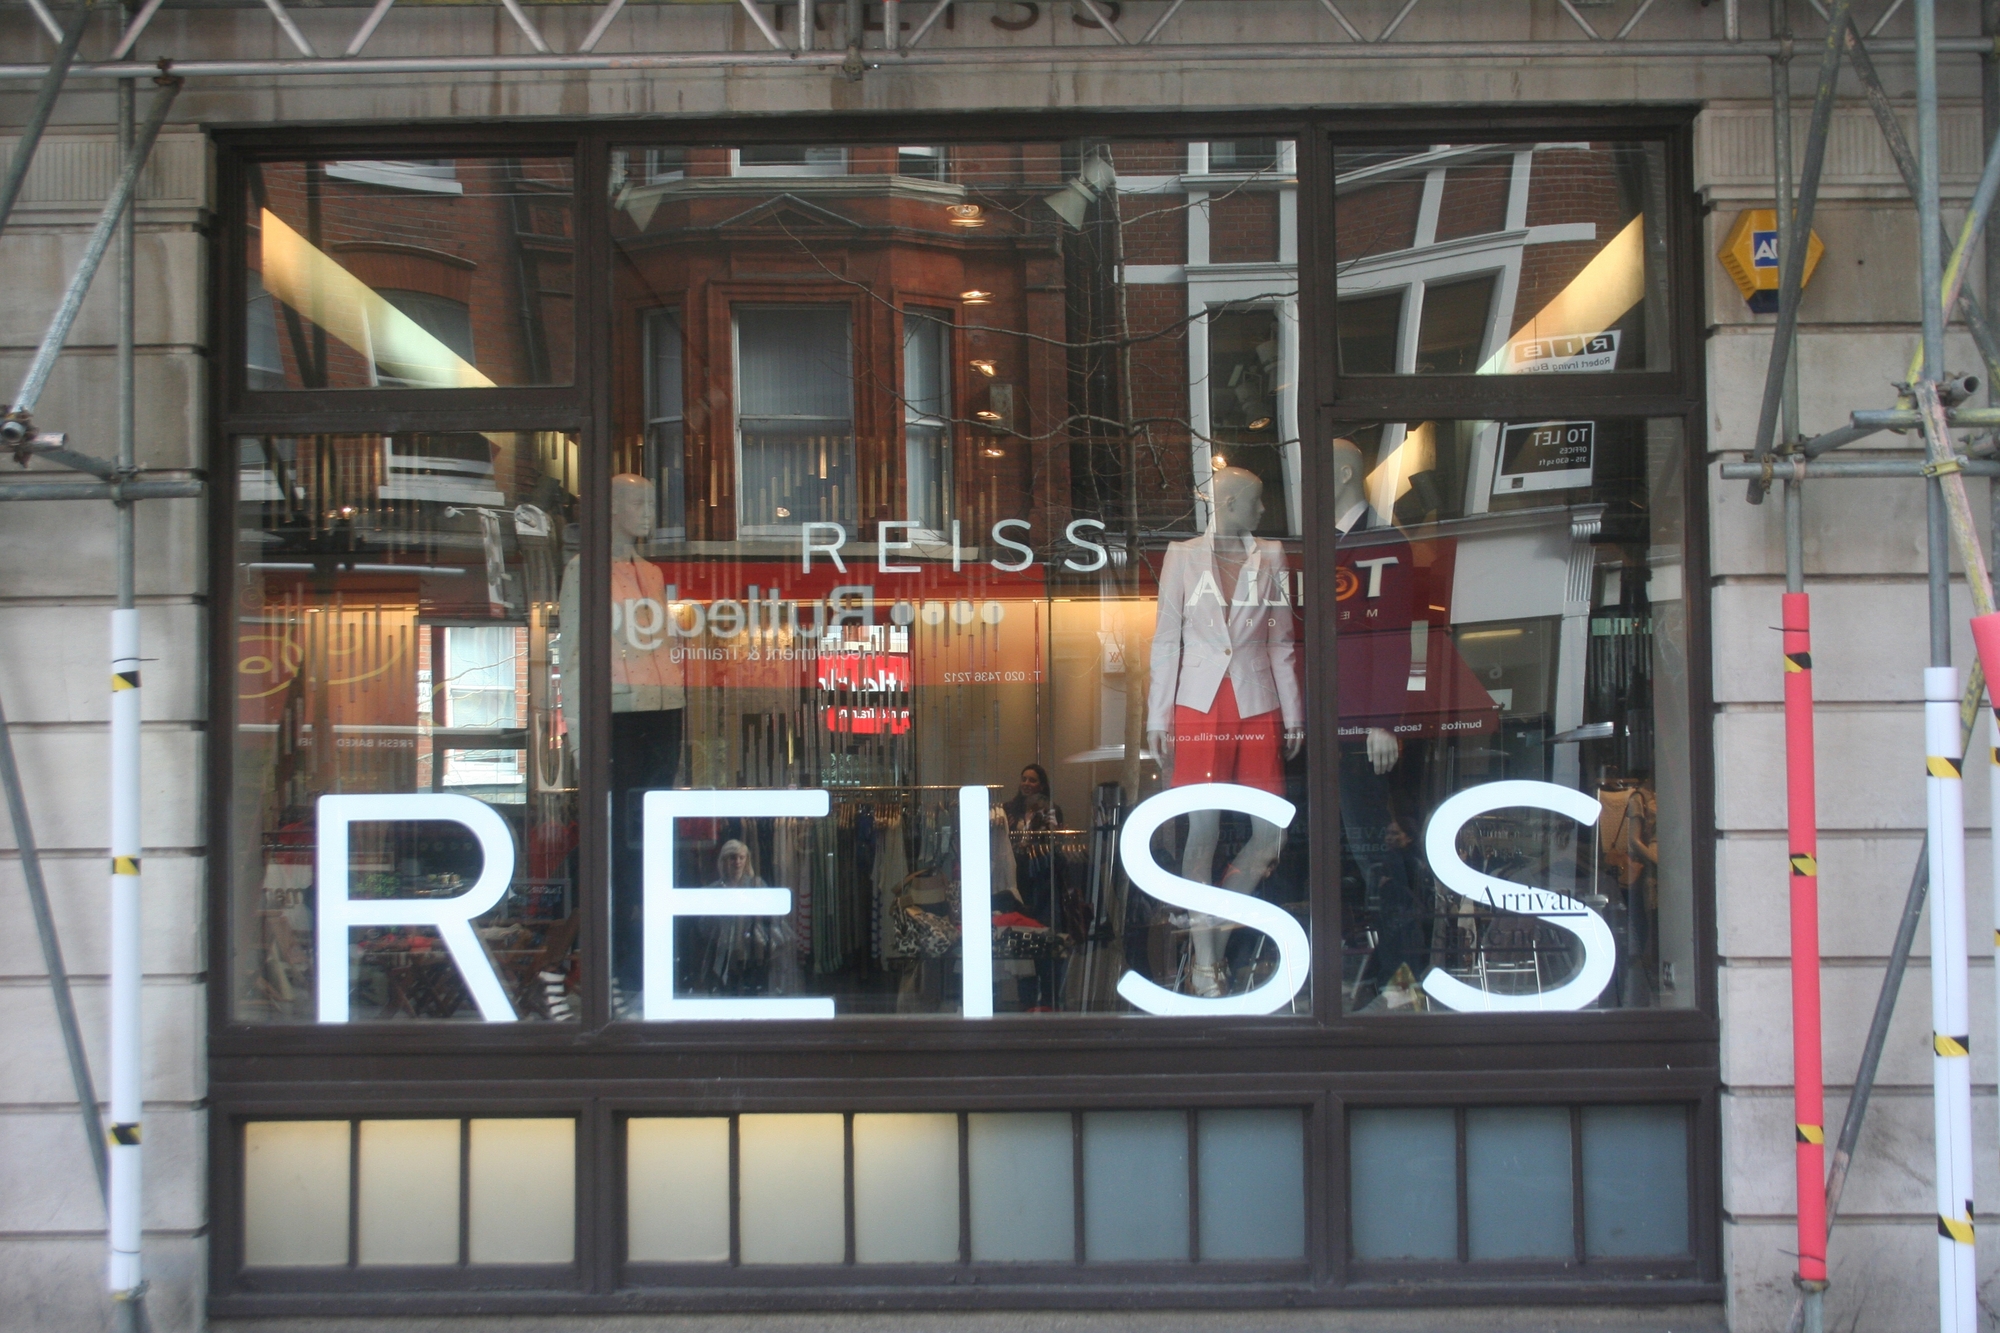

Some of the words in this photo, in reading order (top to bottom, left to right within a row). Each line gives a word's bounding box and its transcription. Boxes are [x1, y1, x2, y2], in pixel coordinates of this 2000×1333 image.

[802, 519, 1108, 574] REISS
[317, 779, 1616, 1023] REISS
[1480, 885, 1587, 912] Arrivals
